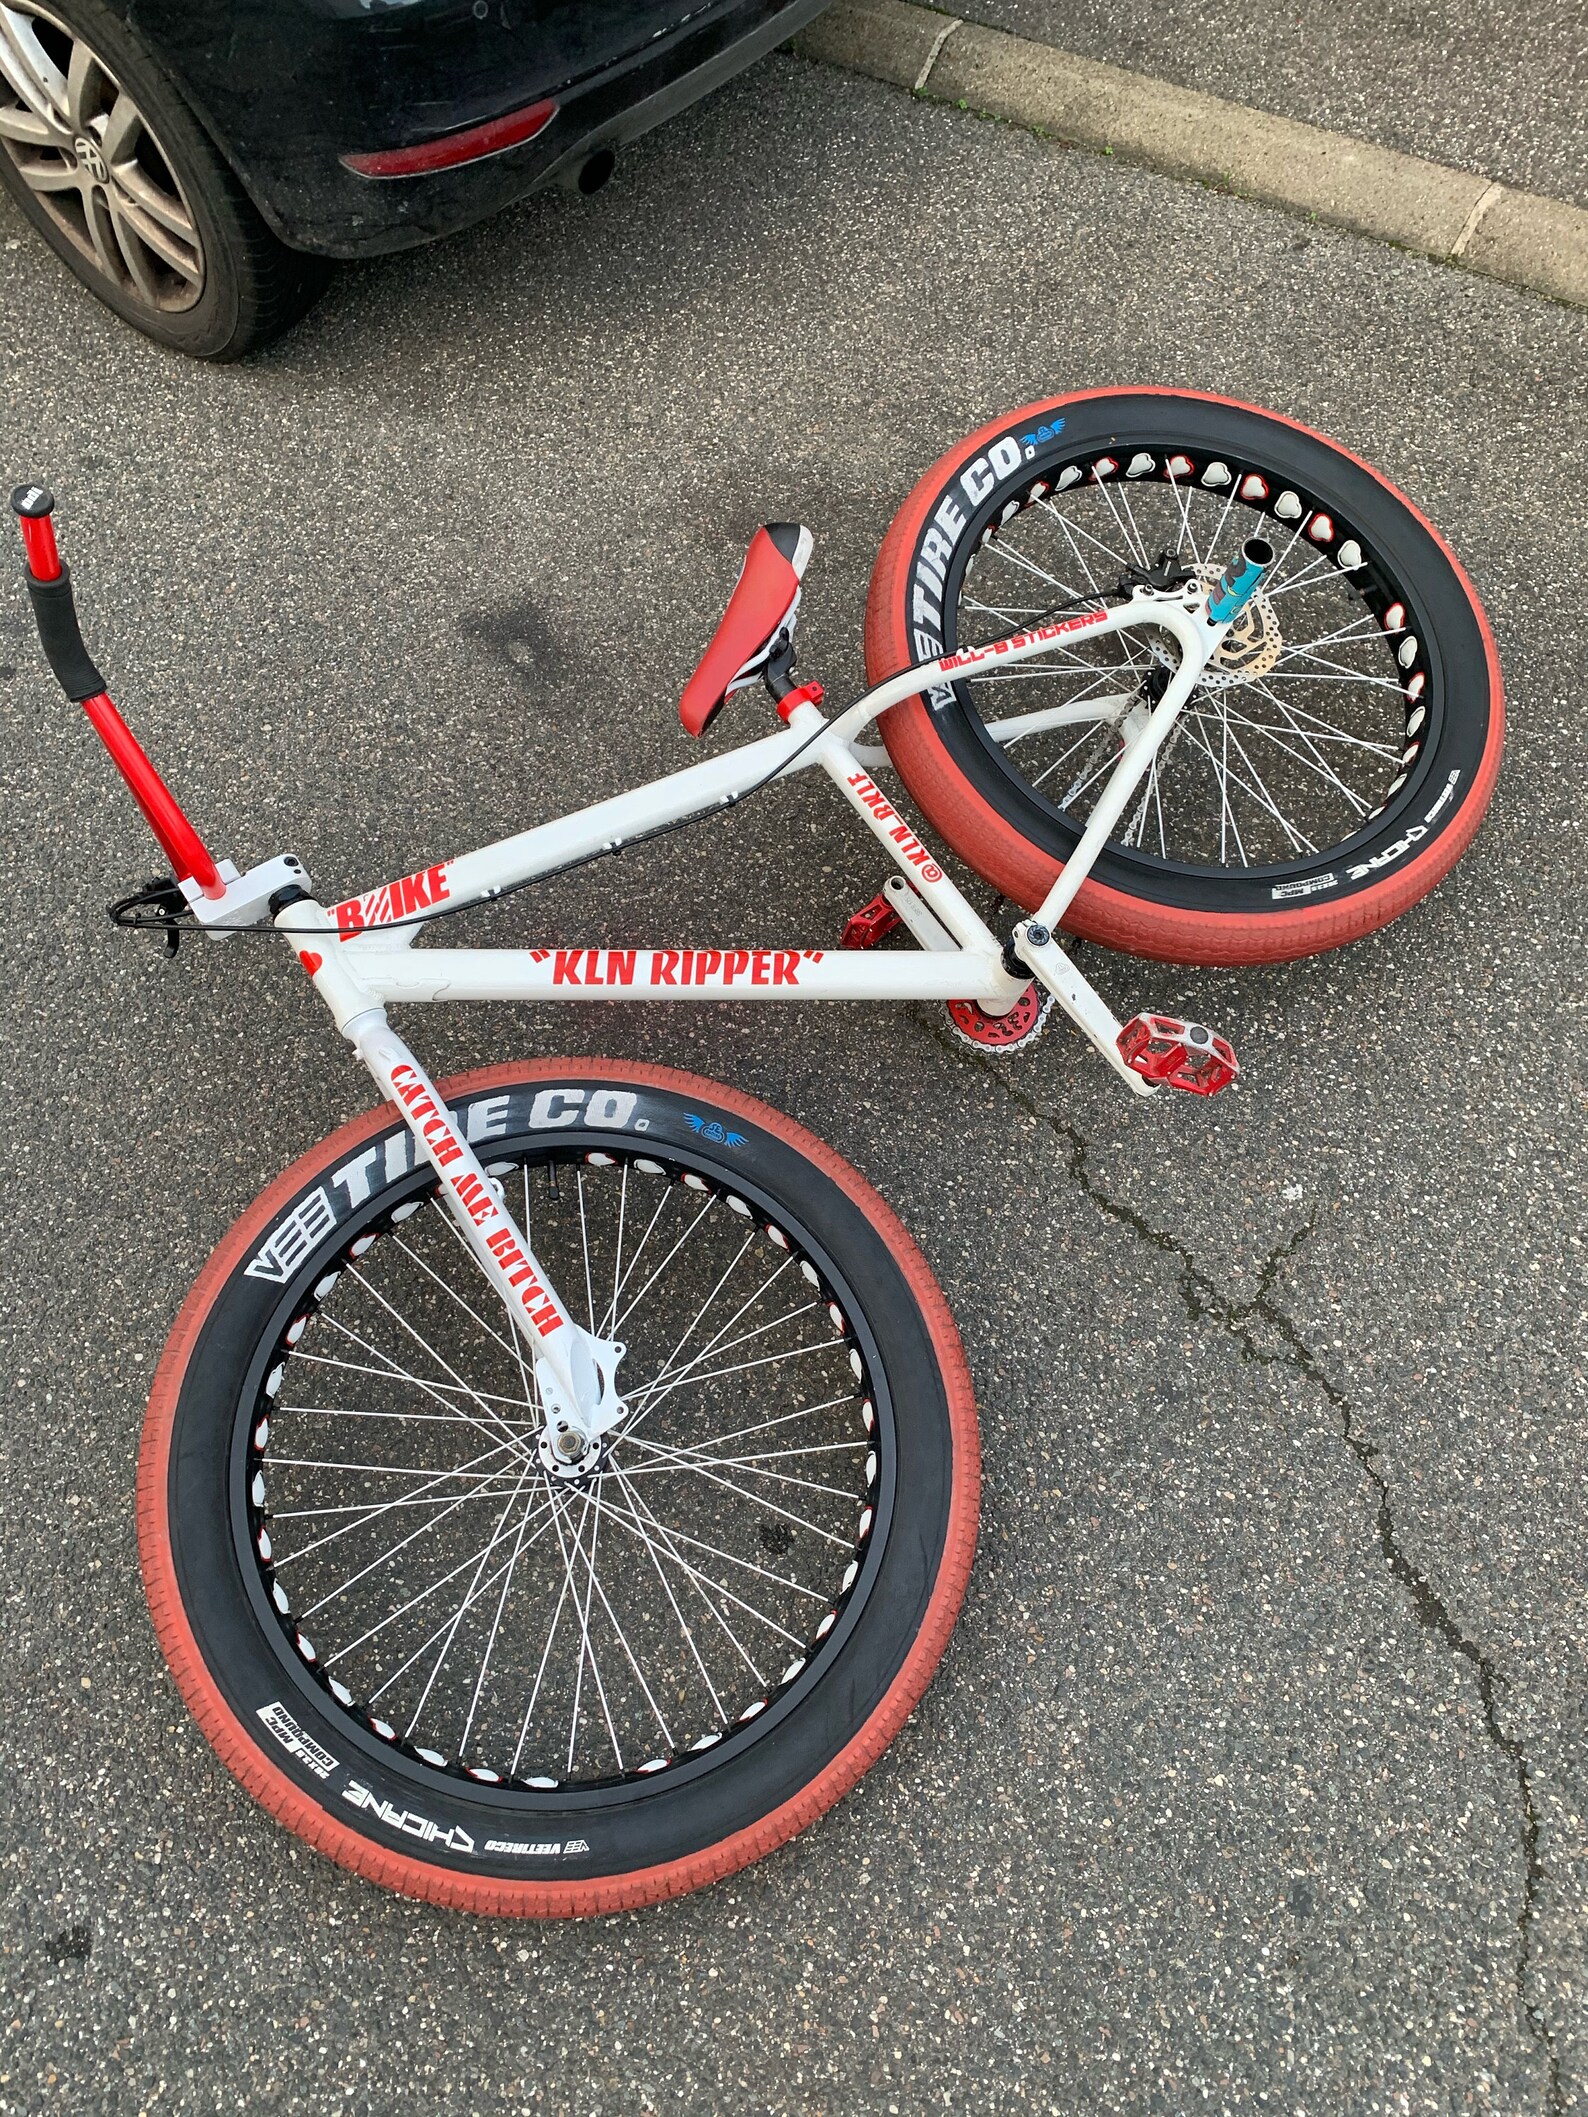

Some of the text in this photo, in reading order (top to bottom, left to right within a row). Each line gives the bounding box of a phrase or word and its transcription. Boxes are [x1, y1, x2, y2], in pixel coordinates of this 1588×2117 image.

[912, 494, 967, 632] TIRE
[959, 435, 1036, 507] CO.
[1012, 610, 1108, 649] STICKERS
[244, 1186, 337, 1284] VEE
[528, 1088, 650, 1132] CO.
[390, 1064, 564, 1338] CATCH ME BITCH
[264, 1715, 294, 1745] MPC
[272, 1705, 337, 1769] COMPOUND
[341, 1780, 476, 1853] CHICANE
[484, 1840, 562, 1852] VEETIRECO
